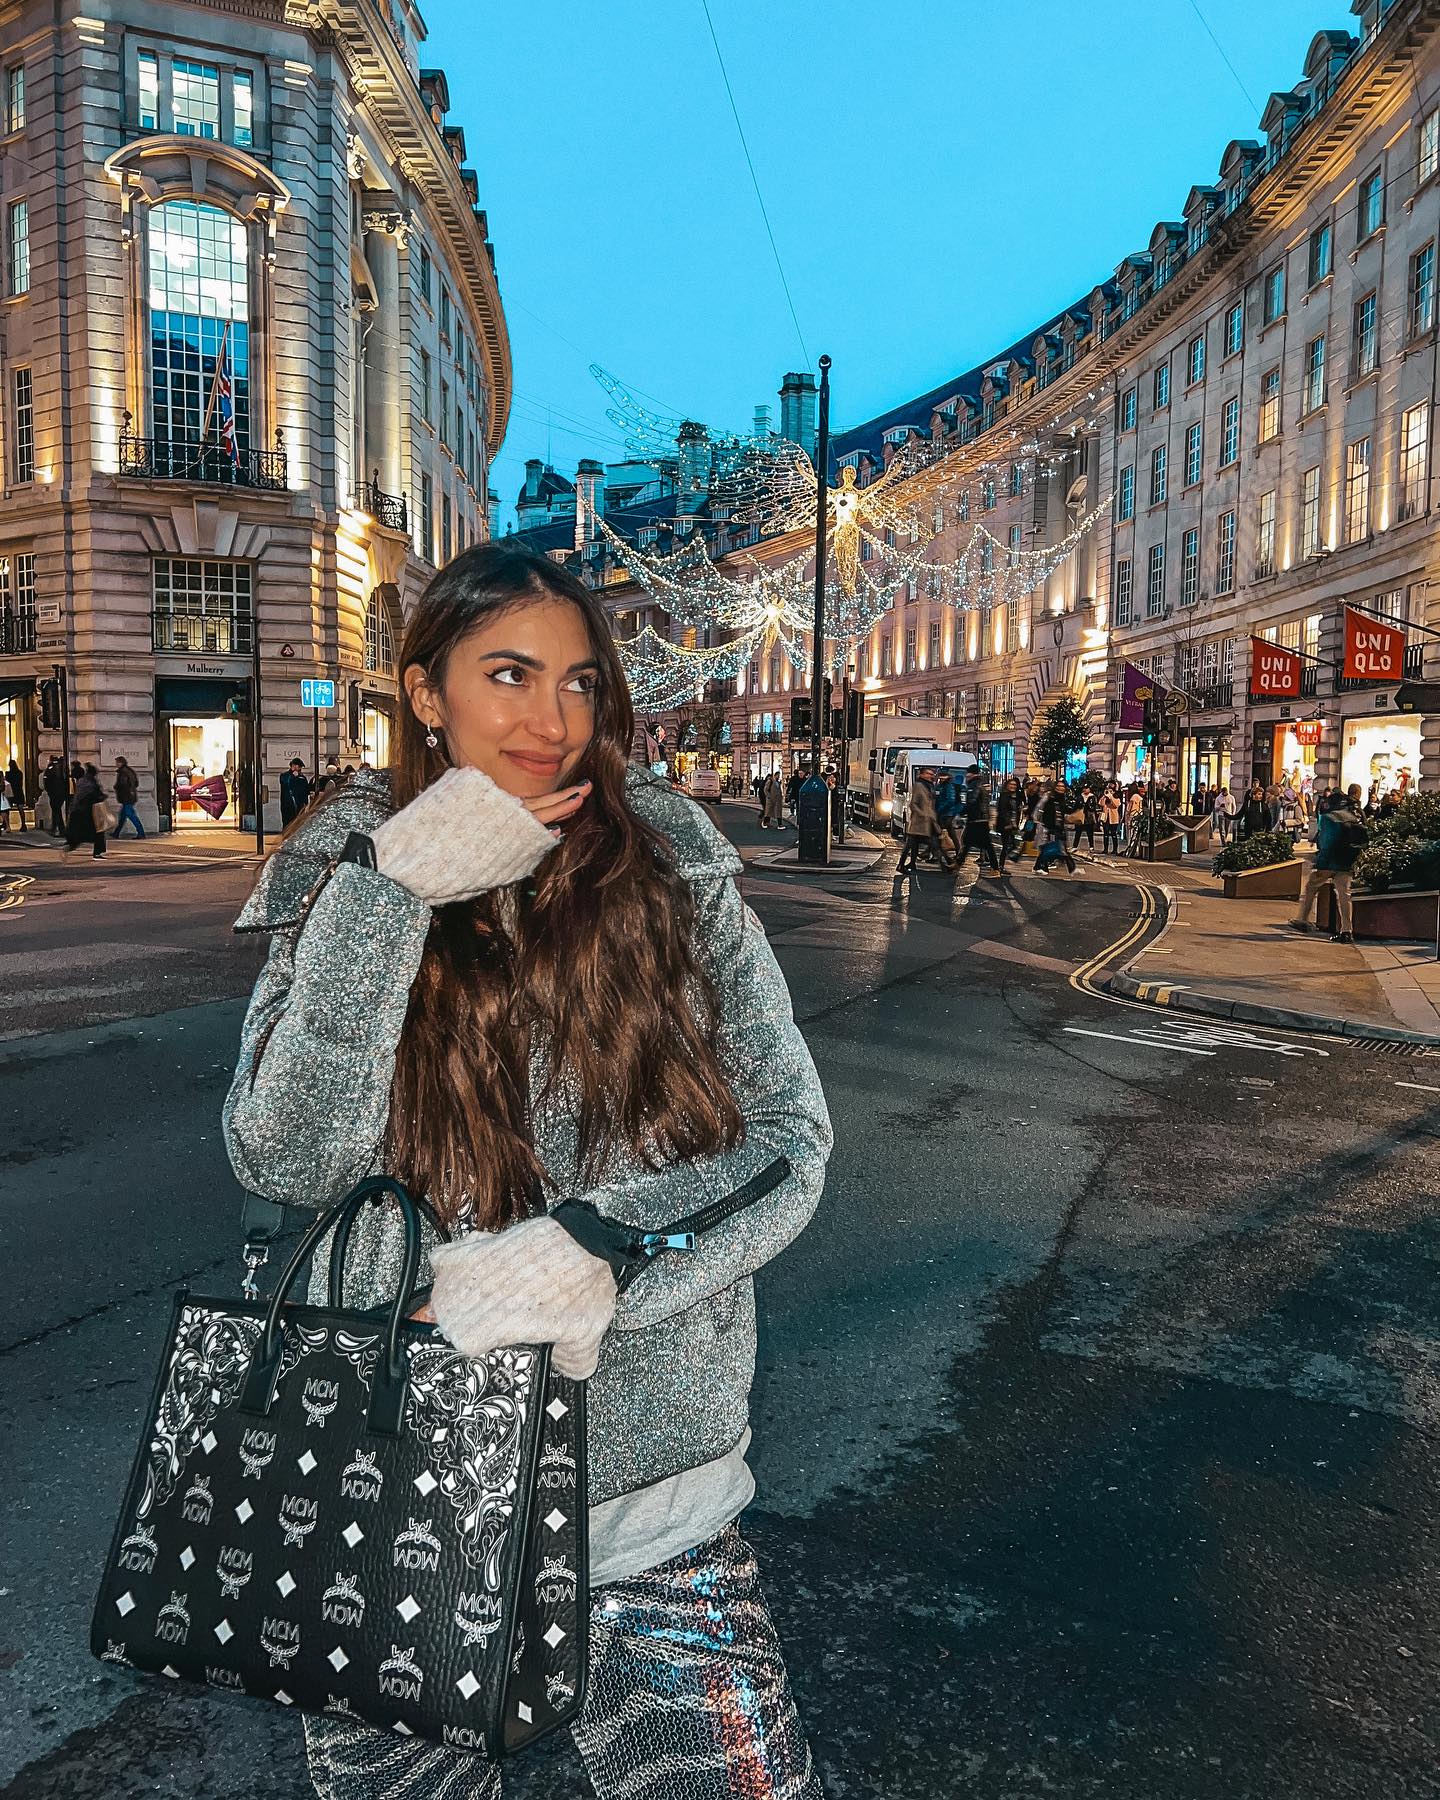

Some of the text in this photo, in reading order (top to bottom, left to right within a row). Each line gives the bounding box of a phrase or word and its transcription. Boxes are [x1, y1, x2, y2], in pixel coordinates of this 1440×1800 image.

[1355, 631, 1391, 652] UNI
[187, 663, 225, 676] Mulberry
[1261, 656, 1291, 673] UNI
[1354, 652, 1392, 674] QLO
[1260, 673, 1292, 690] QLO
[1299, 724, 1318, 734] UNI
[1299, 734, 1319, 744] QLO
[303, 1377, 339, 1400] MCM
[241, 1428, 277, 1452] MCM
[341, 1478, 381, 1502] MCM
[537, 1470, 577, 1489] MCM
[281, 1494, 319, 1520] MCM
[219, 1545, 253, 1572] MCM
[394, 1547, 440, 1572] MCM
[457, 1591, 503, 1617] MCM
[535, 1583, 577, 1606] MCM
[322, 1602, 364, 1629] MCM
[262, 1615, 300, 1643] MCM
[378, 1675, 422, 1702] MCM
[443, 1724, 487, 1750] MCM
